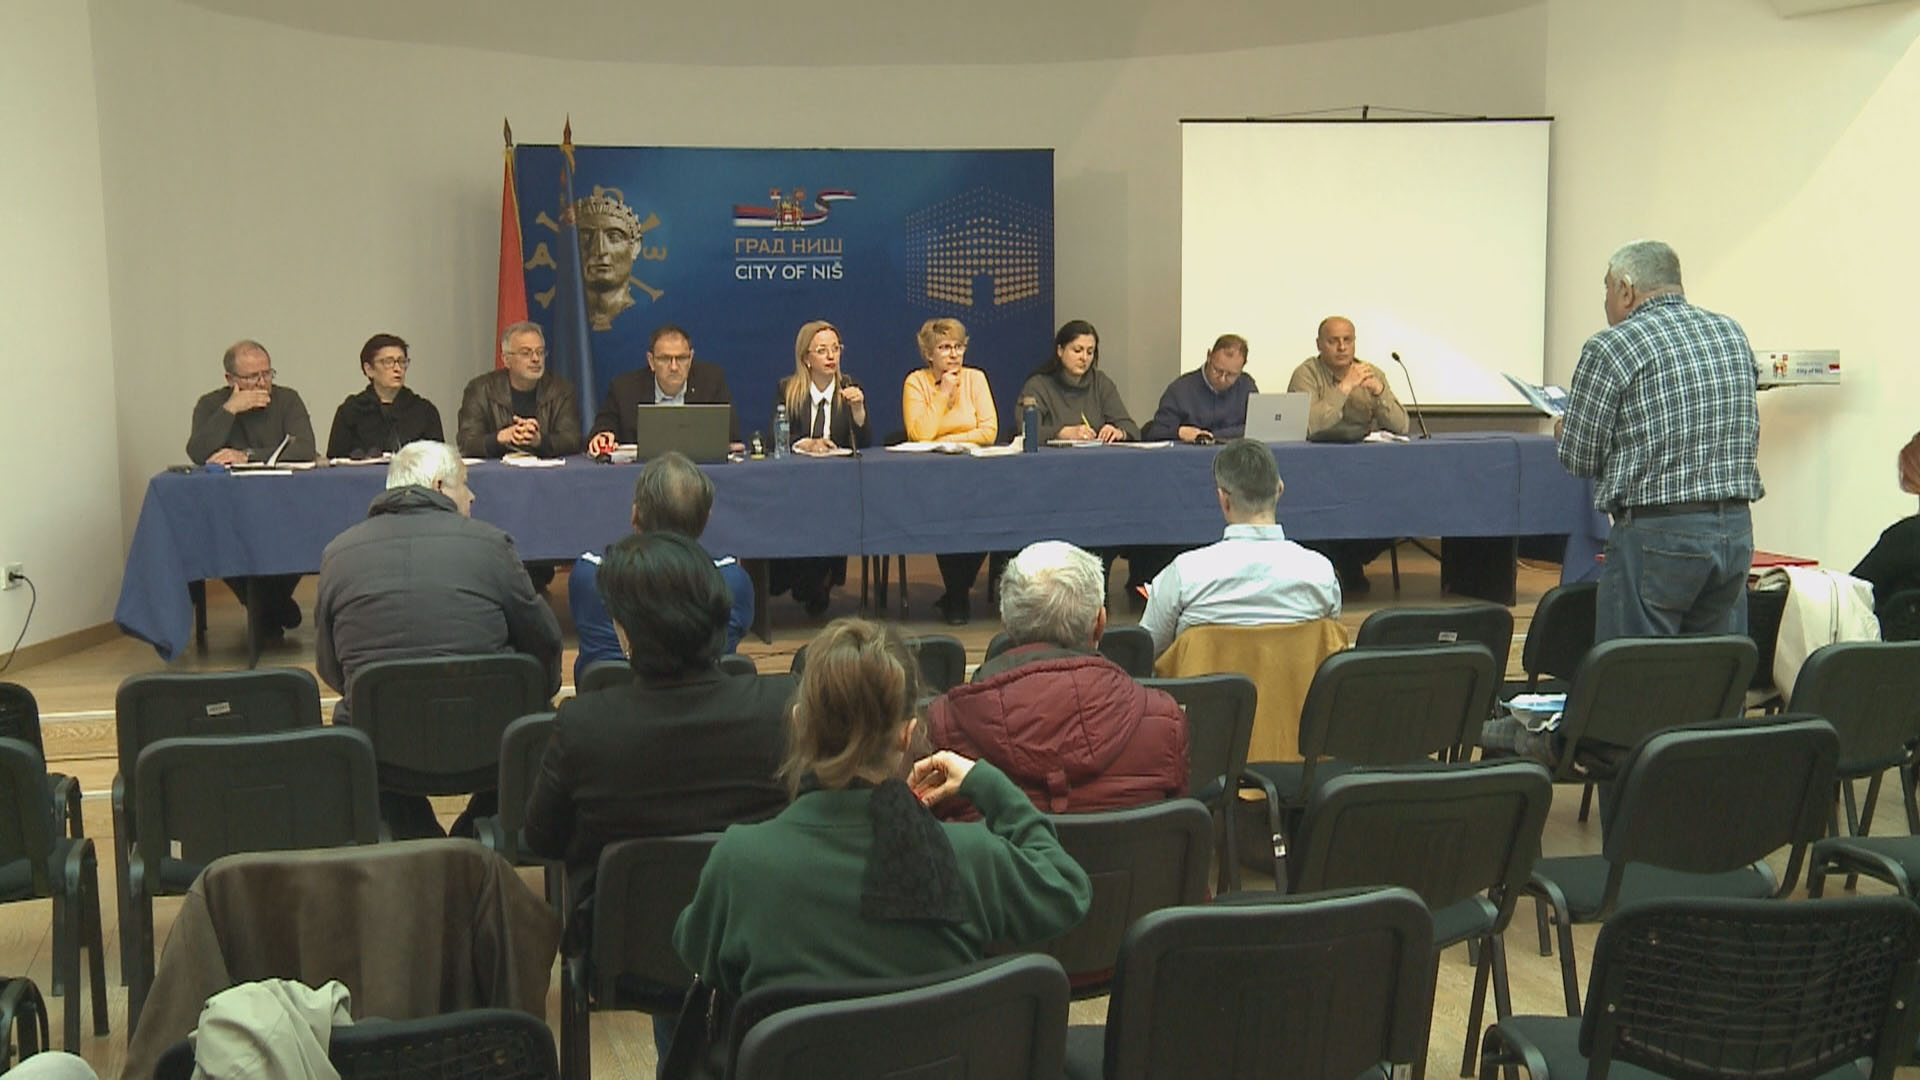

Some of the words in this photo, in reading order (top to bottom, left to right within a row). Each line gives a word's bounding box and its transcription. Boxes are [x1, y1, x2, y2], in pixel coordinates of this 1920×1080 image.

[735, 238, 785, 254] ГРАД
[792, 238, 842, 254] НИШ
[735, 265, 777, 280] CITY
[782, 265, 807, 280] OF
[812, 261, 843, 280] NIŠ
